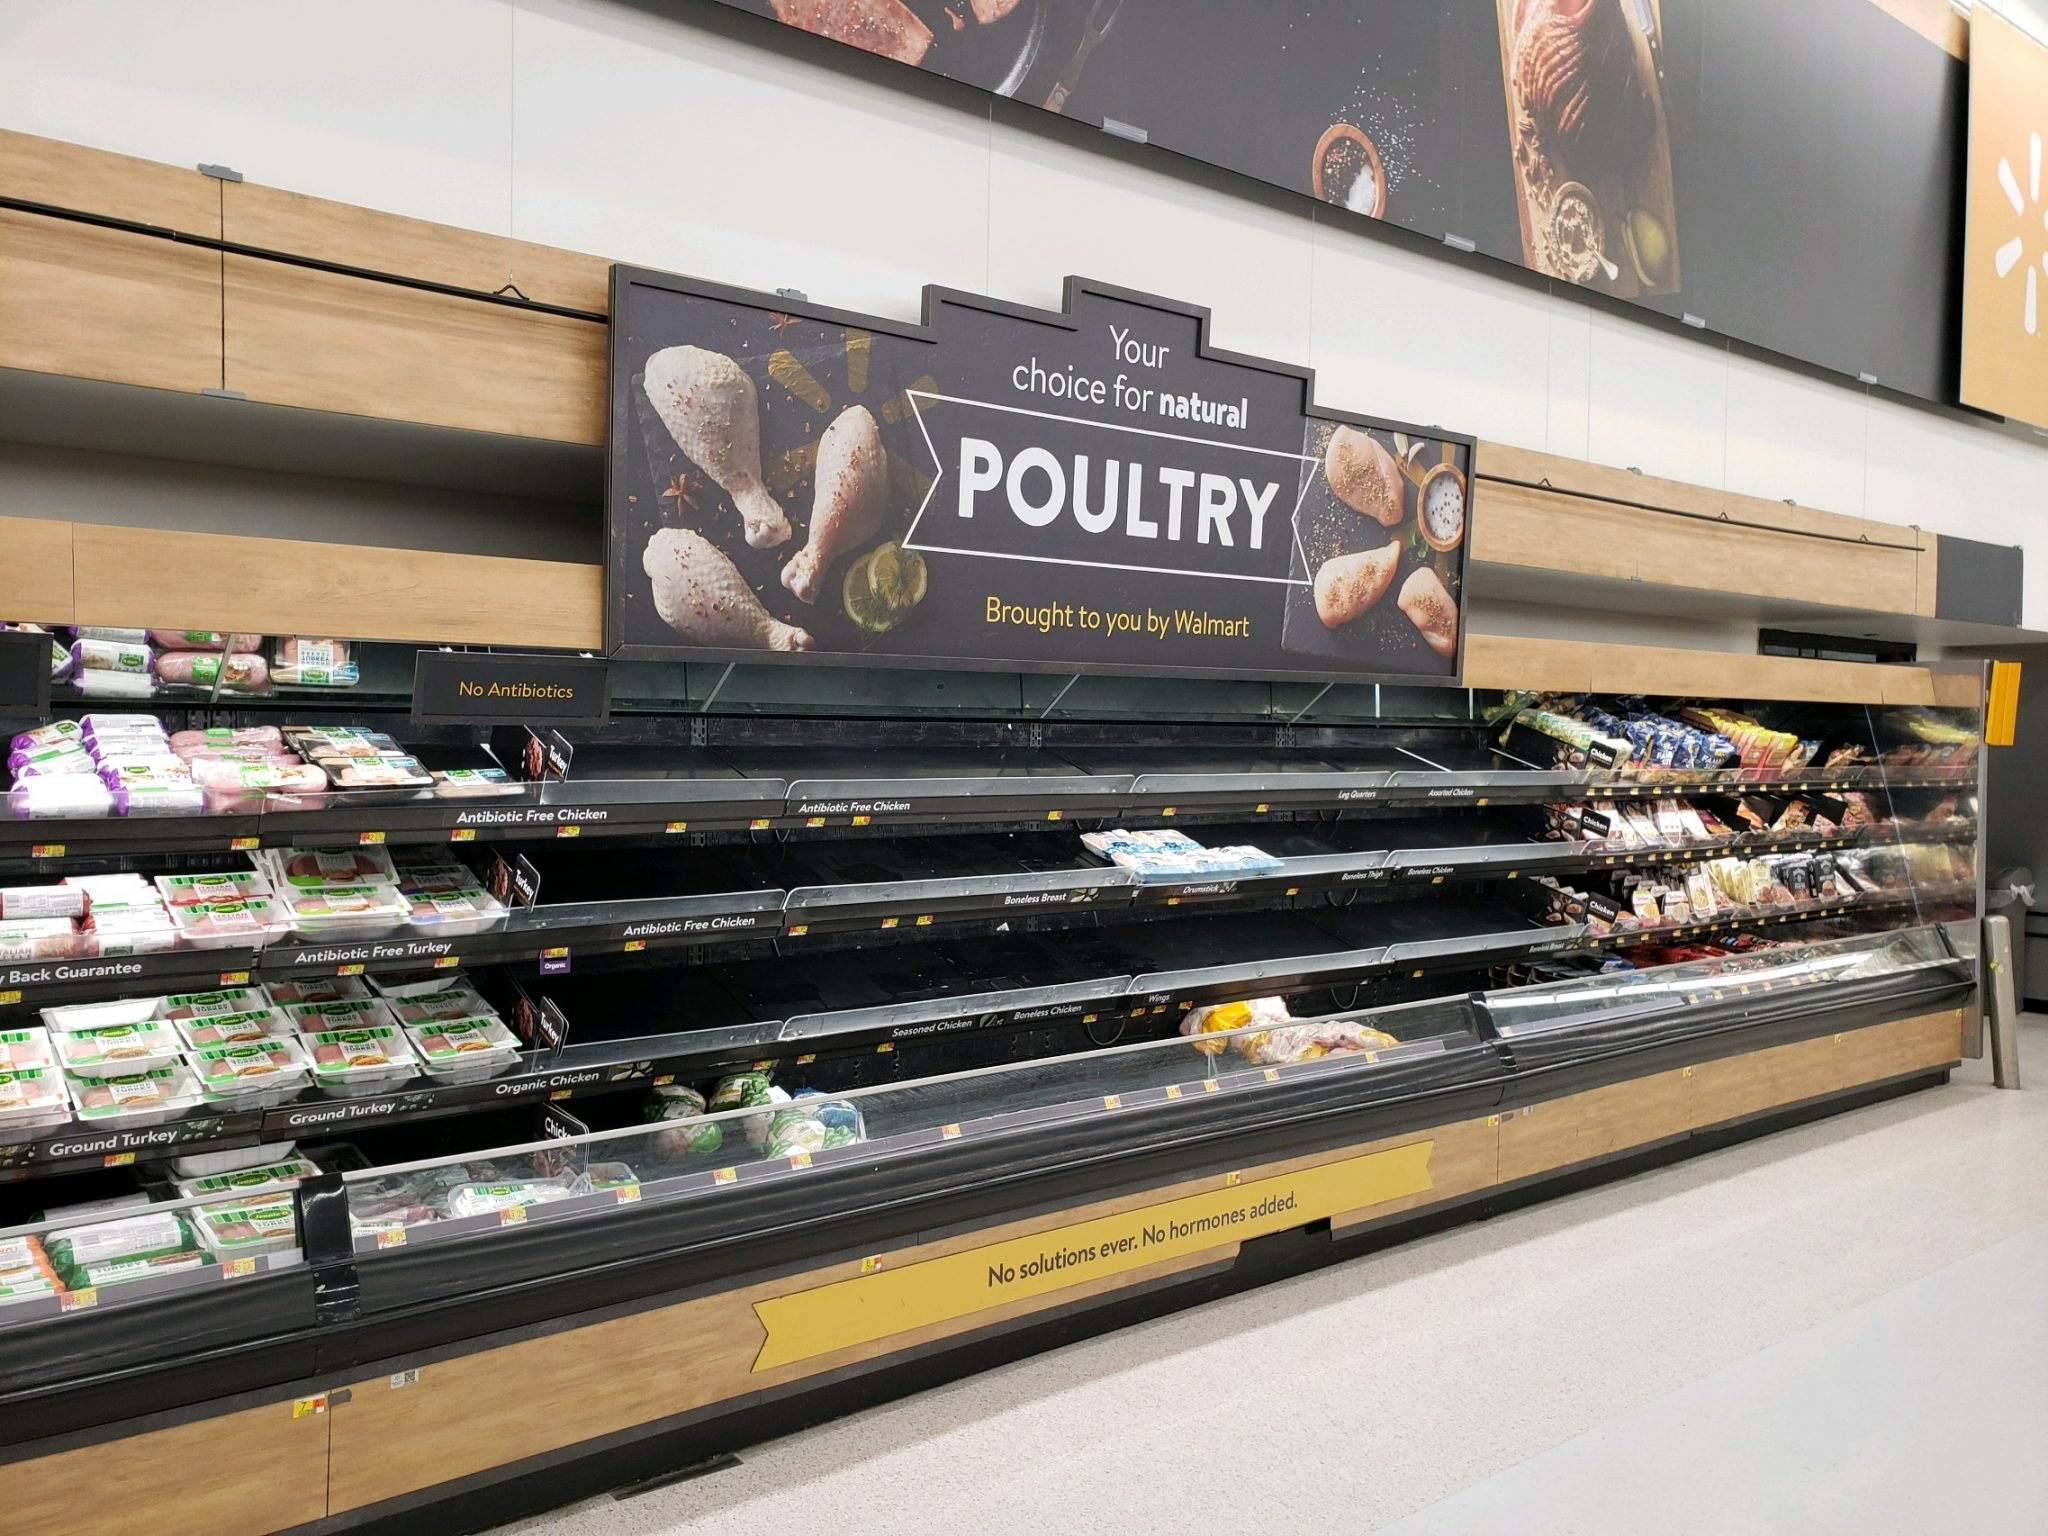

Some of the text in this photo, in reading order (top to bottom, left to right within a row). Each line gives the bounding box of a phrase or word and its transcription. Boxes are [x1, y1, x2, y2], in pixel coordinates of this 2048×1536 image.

[1108, 325, 1170, 369] Your
[1012, 357, 1248, 430] choice for natural
[957, 436, 1281, 551] POULTRY
[985, 595, 1250, 640] Brought to you by Walmart
[458, 680, 574, 700] No Antibiotics
[549, 744, 568, 776] Turkey
[1590, 747, 1614, 764] Chicken
[1452, 787, 1475, 797] Chicken
[456, 807, 608, 824] Antibiotic Free Chicken
[798, 801, 911, 813] Antibiotic Free Chicken
[1582, 815, 1608, 832] Chicken
[514, 871, 535, 902] Turkey
[1182, 883, 1220, 895] Drumstick
[1003, 892, 1068, 906] Boneless Breast
[1588, 899, 1616, 918] Chicken
[623, 916, 756, 937] Antibiotic Free Chicken
[294, 941, 453, 964] Antibiotic Free Turkey
[10, 968, 52, 983] Back
[55, 963, 142, 979] Guarantee
[544, 962, 567, 972] Organic
[1148, 994, 1171, 1004] Wings
[1013, 1003, 1082, 1020] Boneless Chicken
[540, 1012, 560, 1046] Turkey
[891, 1018, 973, 1038] Seasoned Chicken
[495, 1072, 600, 1096] Organic Chicken
[289, 1102, 397, 1126] Ground Turkey
[49, 1130, 178, 1156] Ground Turkey
[986, 1192, 1298, 1289] No solutions ever. No hormones added.
